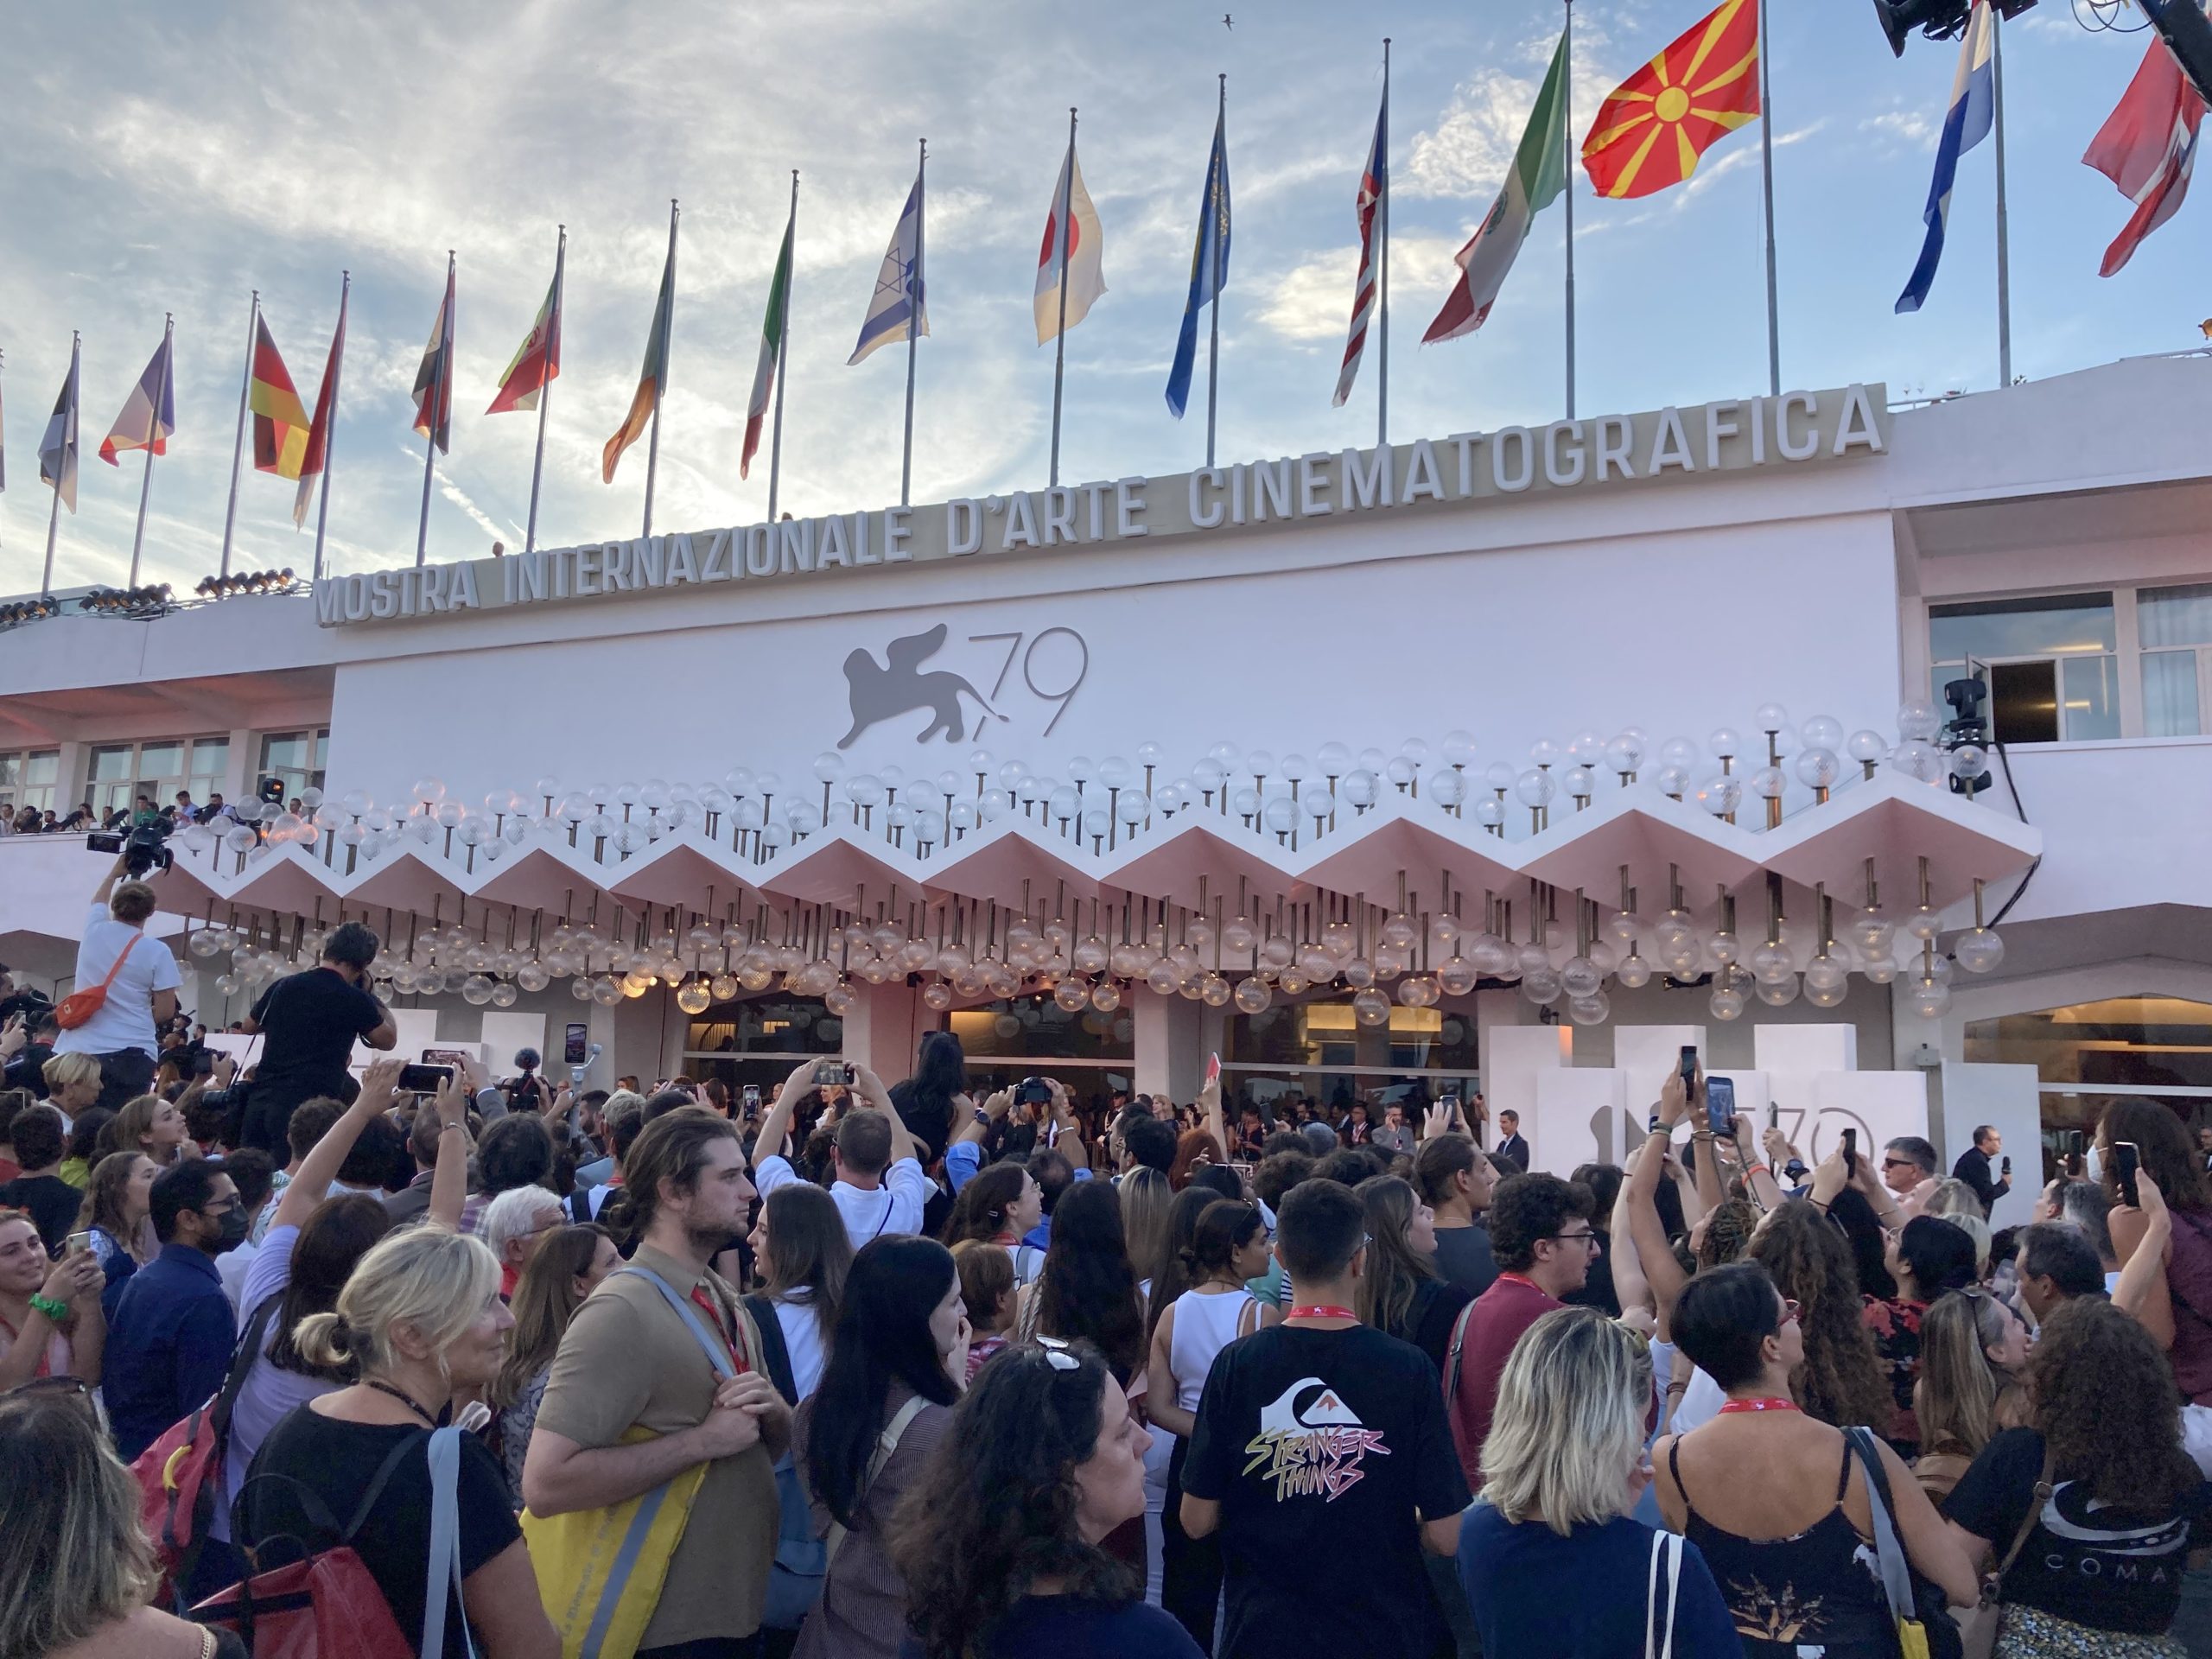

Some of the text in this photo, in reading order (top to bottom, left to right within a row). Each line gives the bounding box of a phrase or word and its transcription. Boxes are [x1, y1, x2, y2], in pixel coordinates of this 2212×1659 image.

[316, 383, 1884, 624] MOSTRA INTERNAZIONALE D'ARTE CINEMATOGRAFICA
[968, 626, 1088, 741] 79
[1242, 1425, 1392, 1477] STRANGER
[1262, 1457, 1365, 1503] THINGS
[2045, 1554, 2167, 1583] COMA
